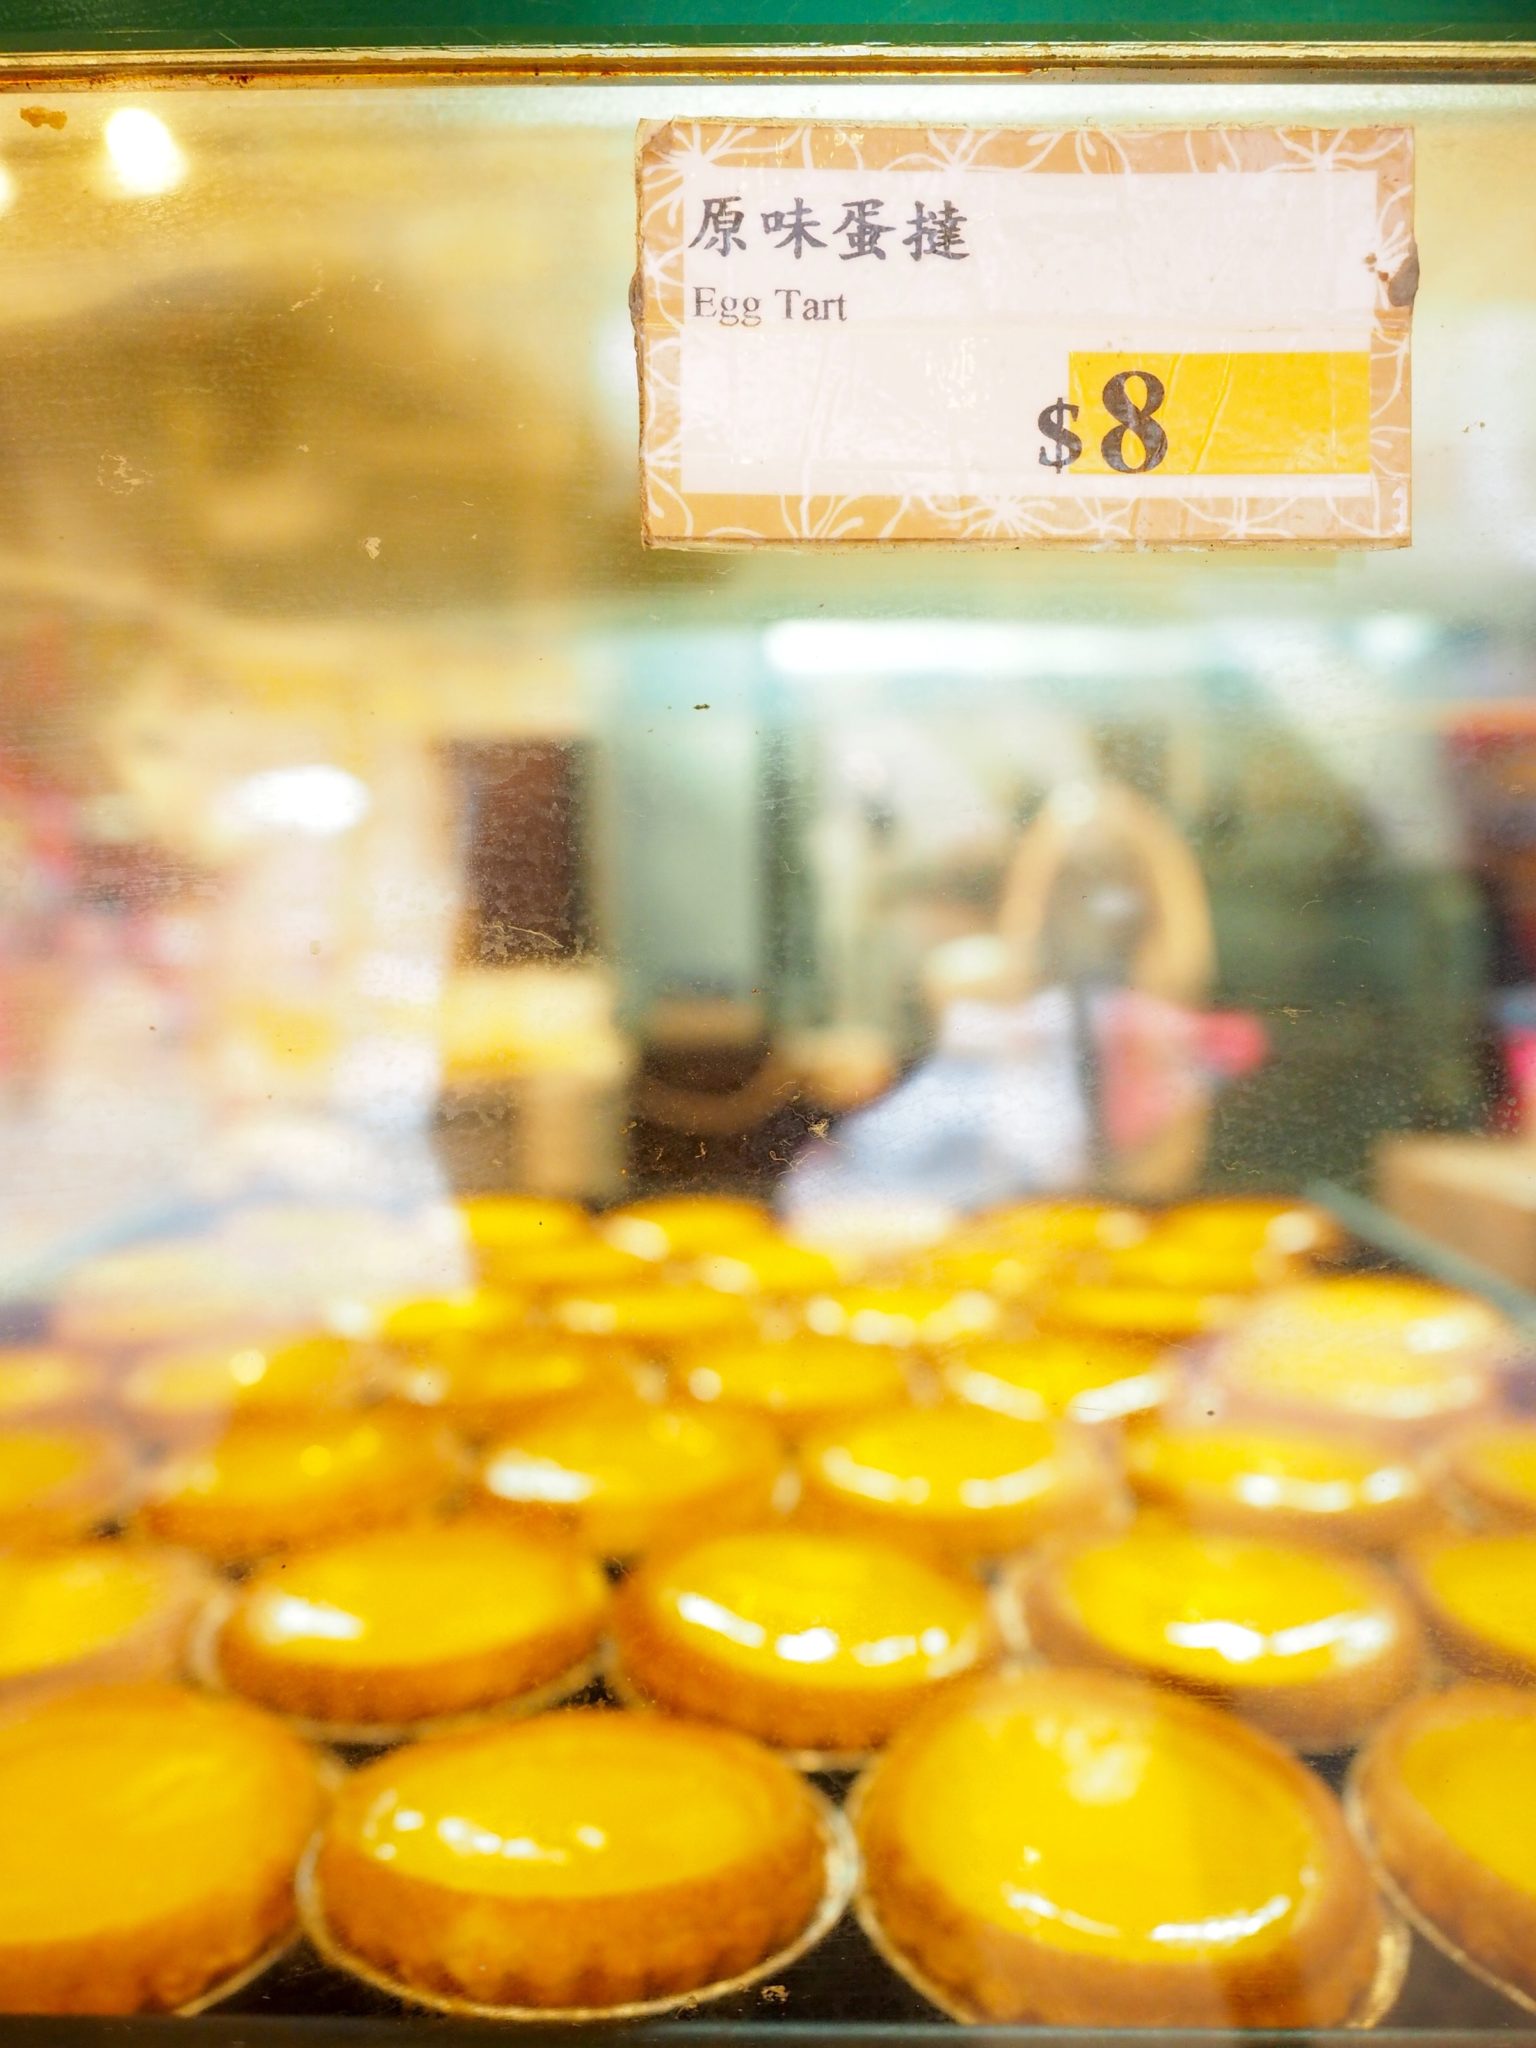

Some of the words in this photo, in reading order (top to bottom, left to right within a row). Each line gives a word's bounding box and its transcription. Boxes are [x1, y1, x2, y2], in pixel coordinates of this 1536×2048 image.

[688, 196, 970, 262] 原味蛋撻
[693, 287, 762, 327] Egg
[775, 289, 848, 322] Tart
[1038, 370, 1168, 474] $8
